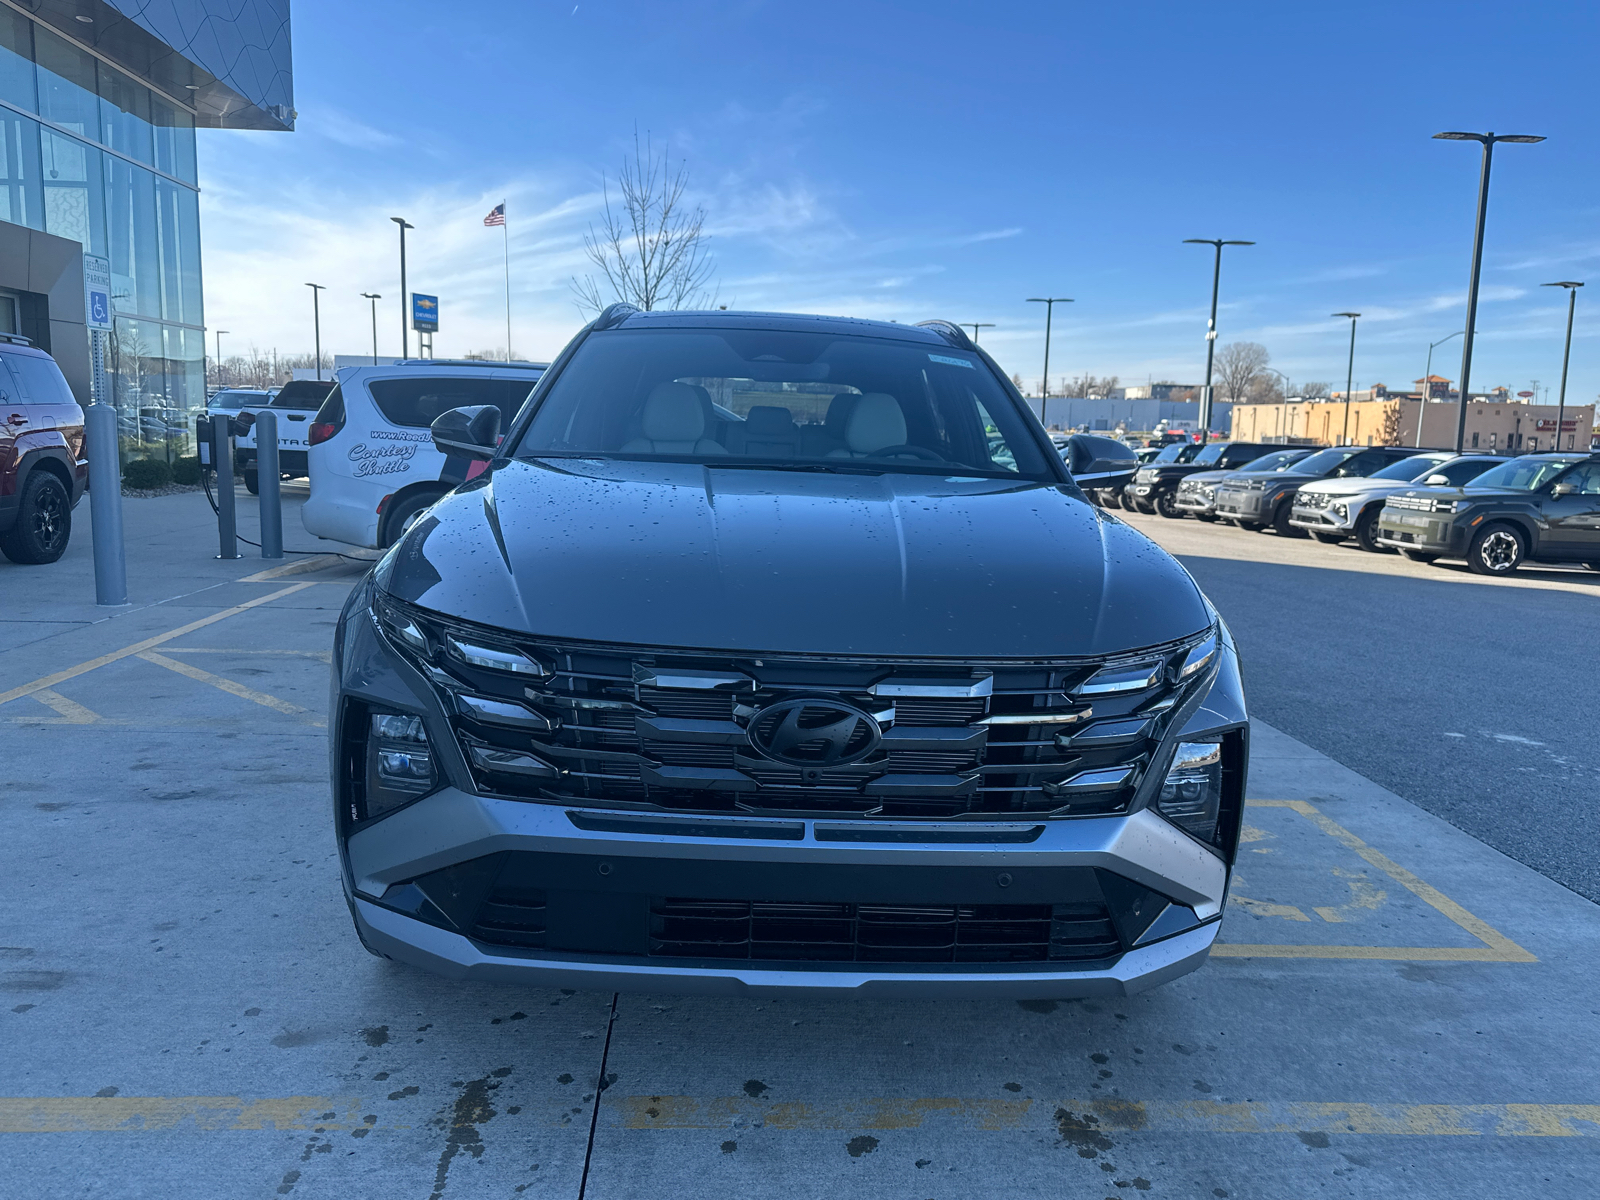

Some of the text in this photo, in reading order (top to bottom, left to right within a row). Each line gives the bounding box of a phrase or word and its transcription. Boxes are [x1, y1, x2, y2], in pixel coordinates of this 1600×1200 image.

[86, 260, 107, 274] RESERVED
[86, 273, 109, 286] PARKING
[348, 443, 418, 461] Courtesy
[353, 458, 410, 477] Shuttle
